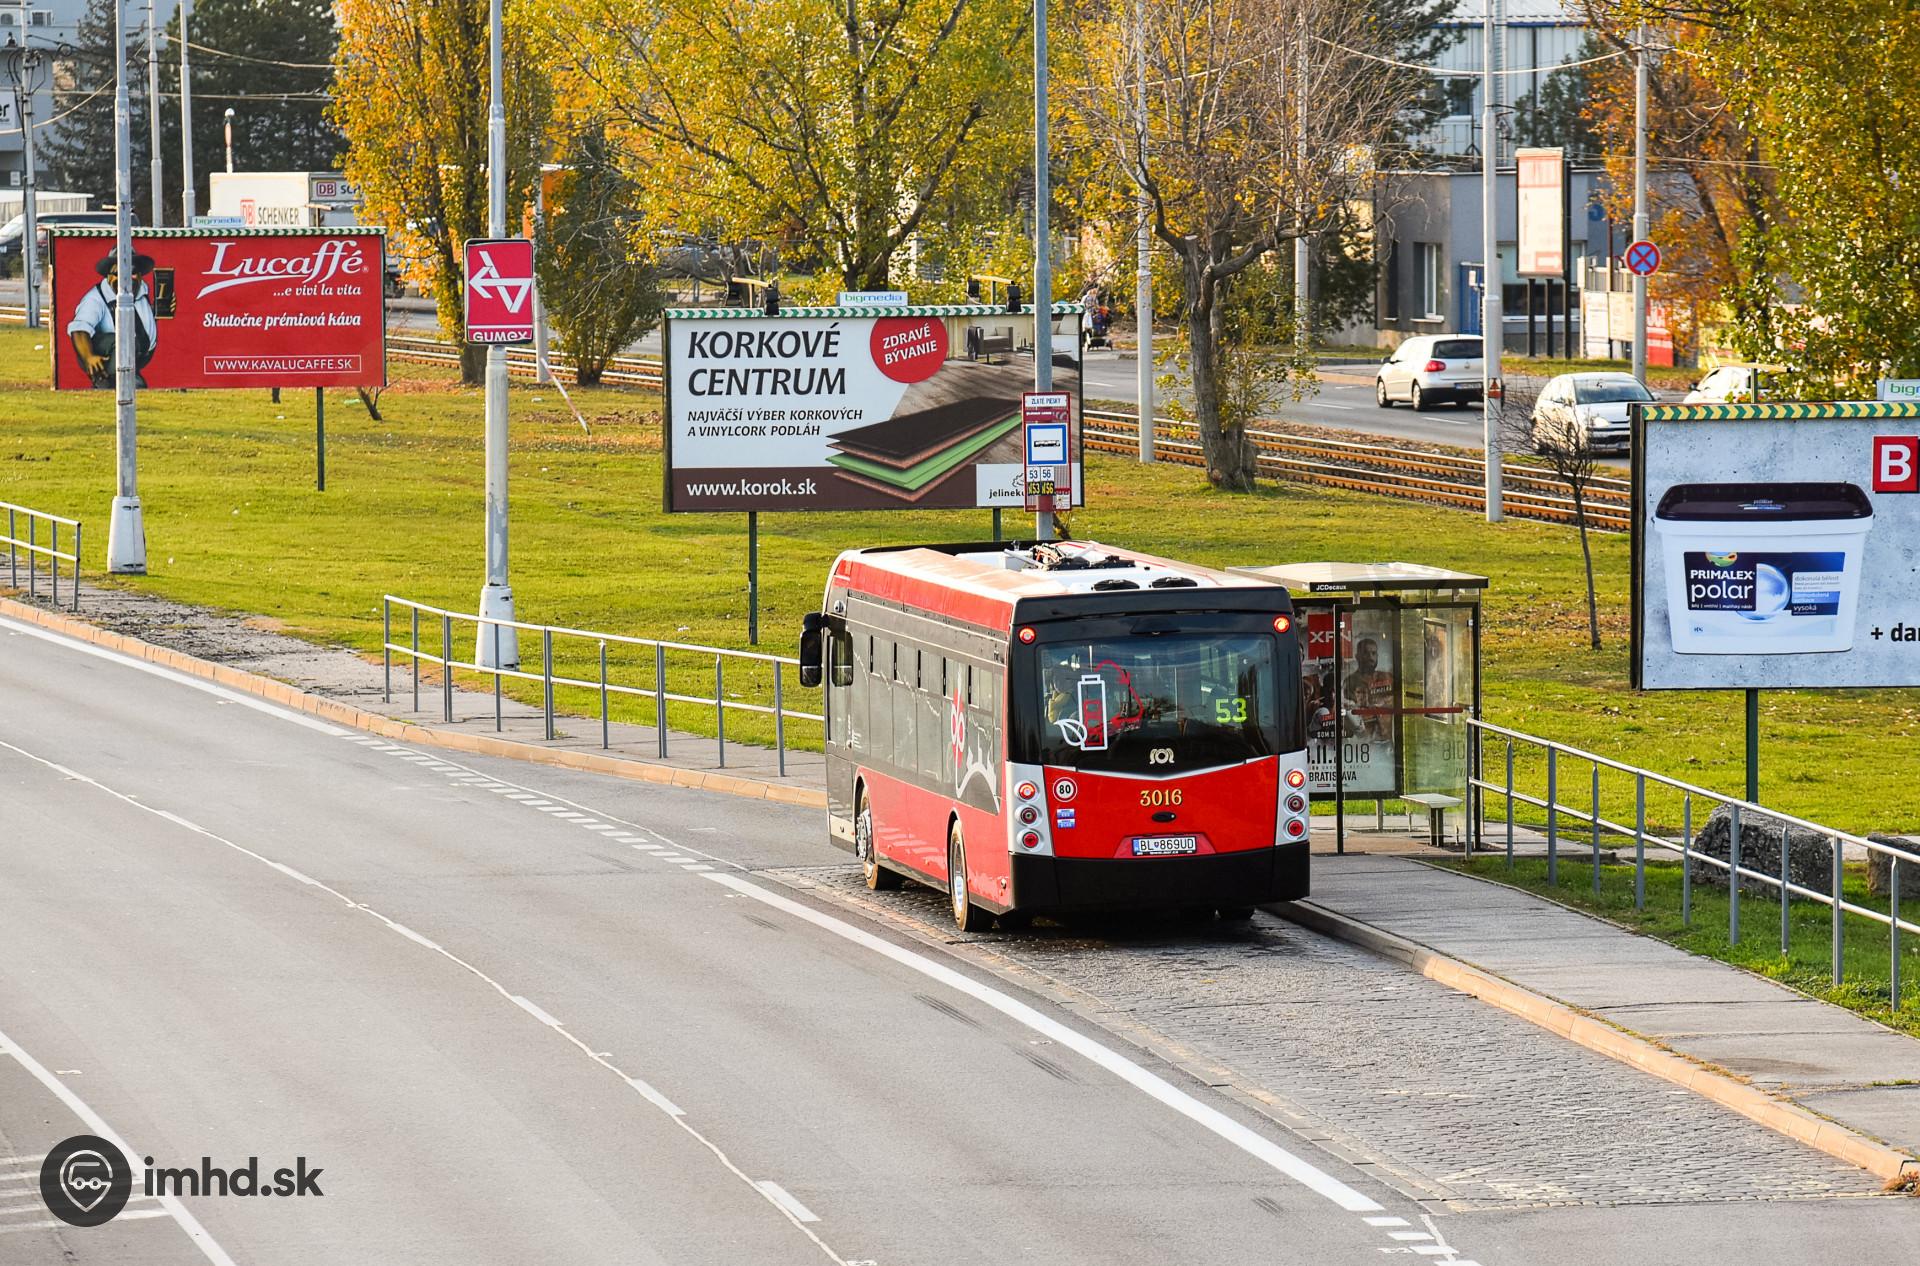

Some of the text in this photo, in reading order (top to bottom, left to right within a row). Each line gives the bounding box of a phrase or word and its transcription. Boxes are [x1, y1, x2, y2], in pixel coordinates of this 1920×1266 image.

[320, 184, 334, 195] DB
[258, 207, 300, 225] SCHENKER
[201, 240, 364, 284] Lucaffé
[296, 284, 317, 296] vivi
[320, 284, 333, 296] la
[337, 285, 361, 296] vita
[844, 293, 903, 303] bigmedia
[203, 312, 361, 330] Skutočne prémiová káva
[688, 322, 841, 359] KORKOVÉ
[882, 323, 931, 350] ZDRAVÉ
[884, 340, 938, 366] BÝVANIE
[213, 359, 352, 370] WWW.KAVALUCAFFE.SK
[688, 367, 847, 396] CENTRUM
[1891, 383, 1920, 396] big
[688, 406, 863, 423] NAJVÄČŠÍ VÝBER KORKOVÝCH
[687, 422, 821, 437] A VINYLCORK PODLÁH
[1880, 444, 1912, 483] B
[1029, 469, 1052, 479] 53 56
[686, 478, 817, 496] www.korok.sk
[1690, 569, 1753, 581] PRIMALEX
[1691, 580, 1753, 603] polar
[1216, 698, 1247, 724] 53
[1308, 771, 1357, 782] BRATISAVA
[1058, 784, 1072, 796] 80
[1139, 788, 1183, 807] 3016
